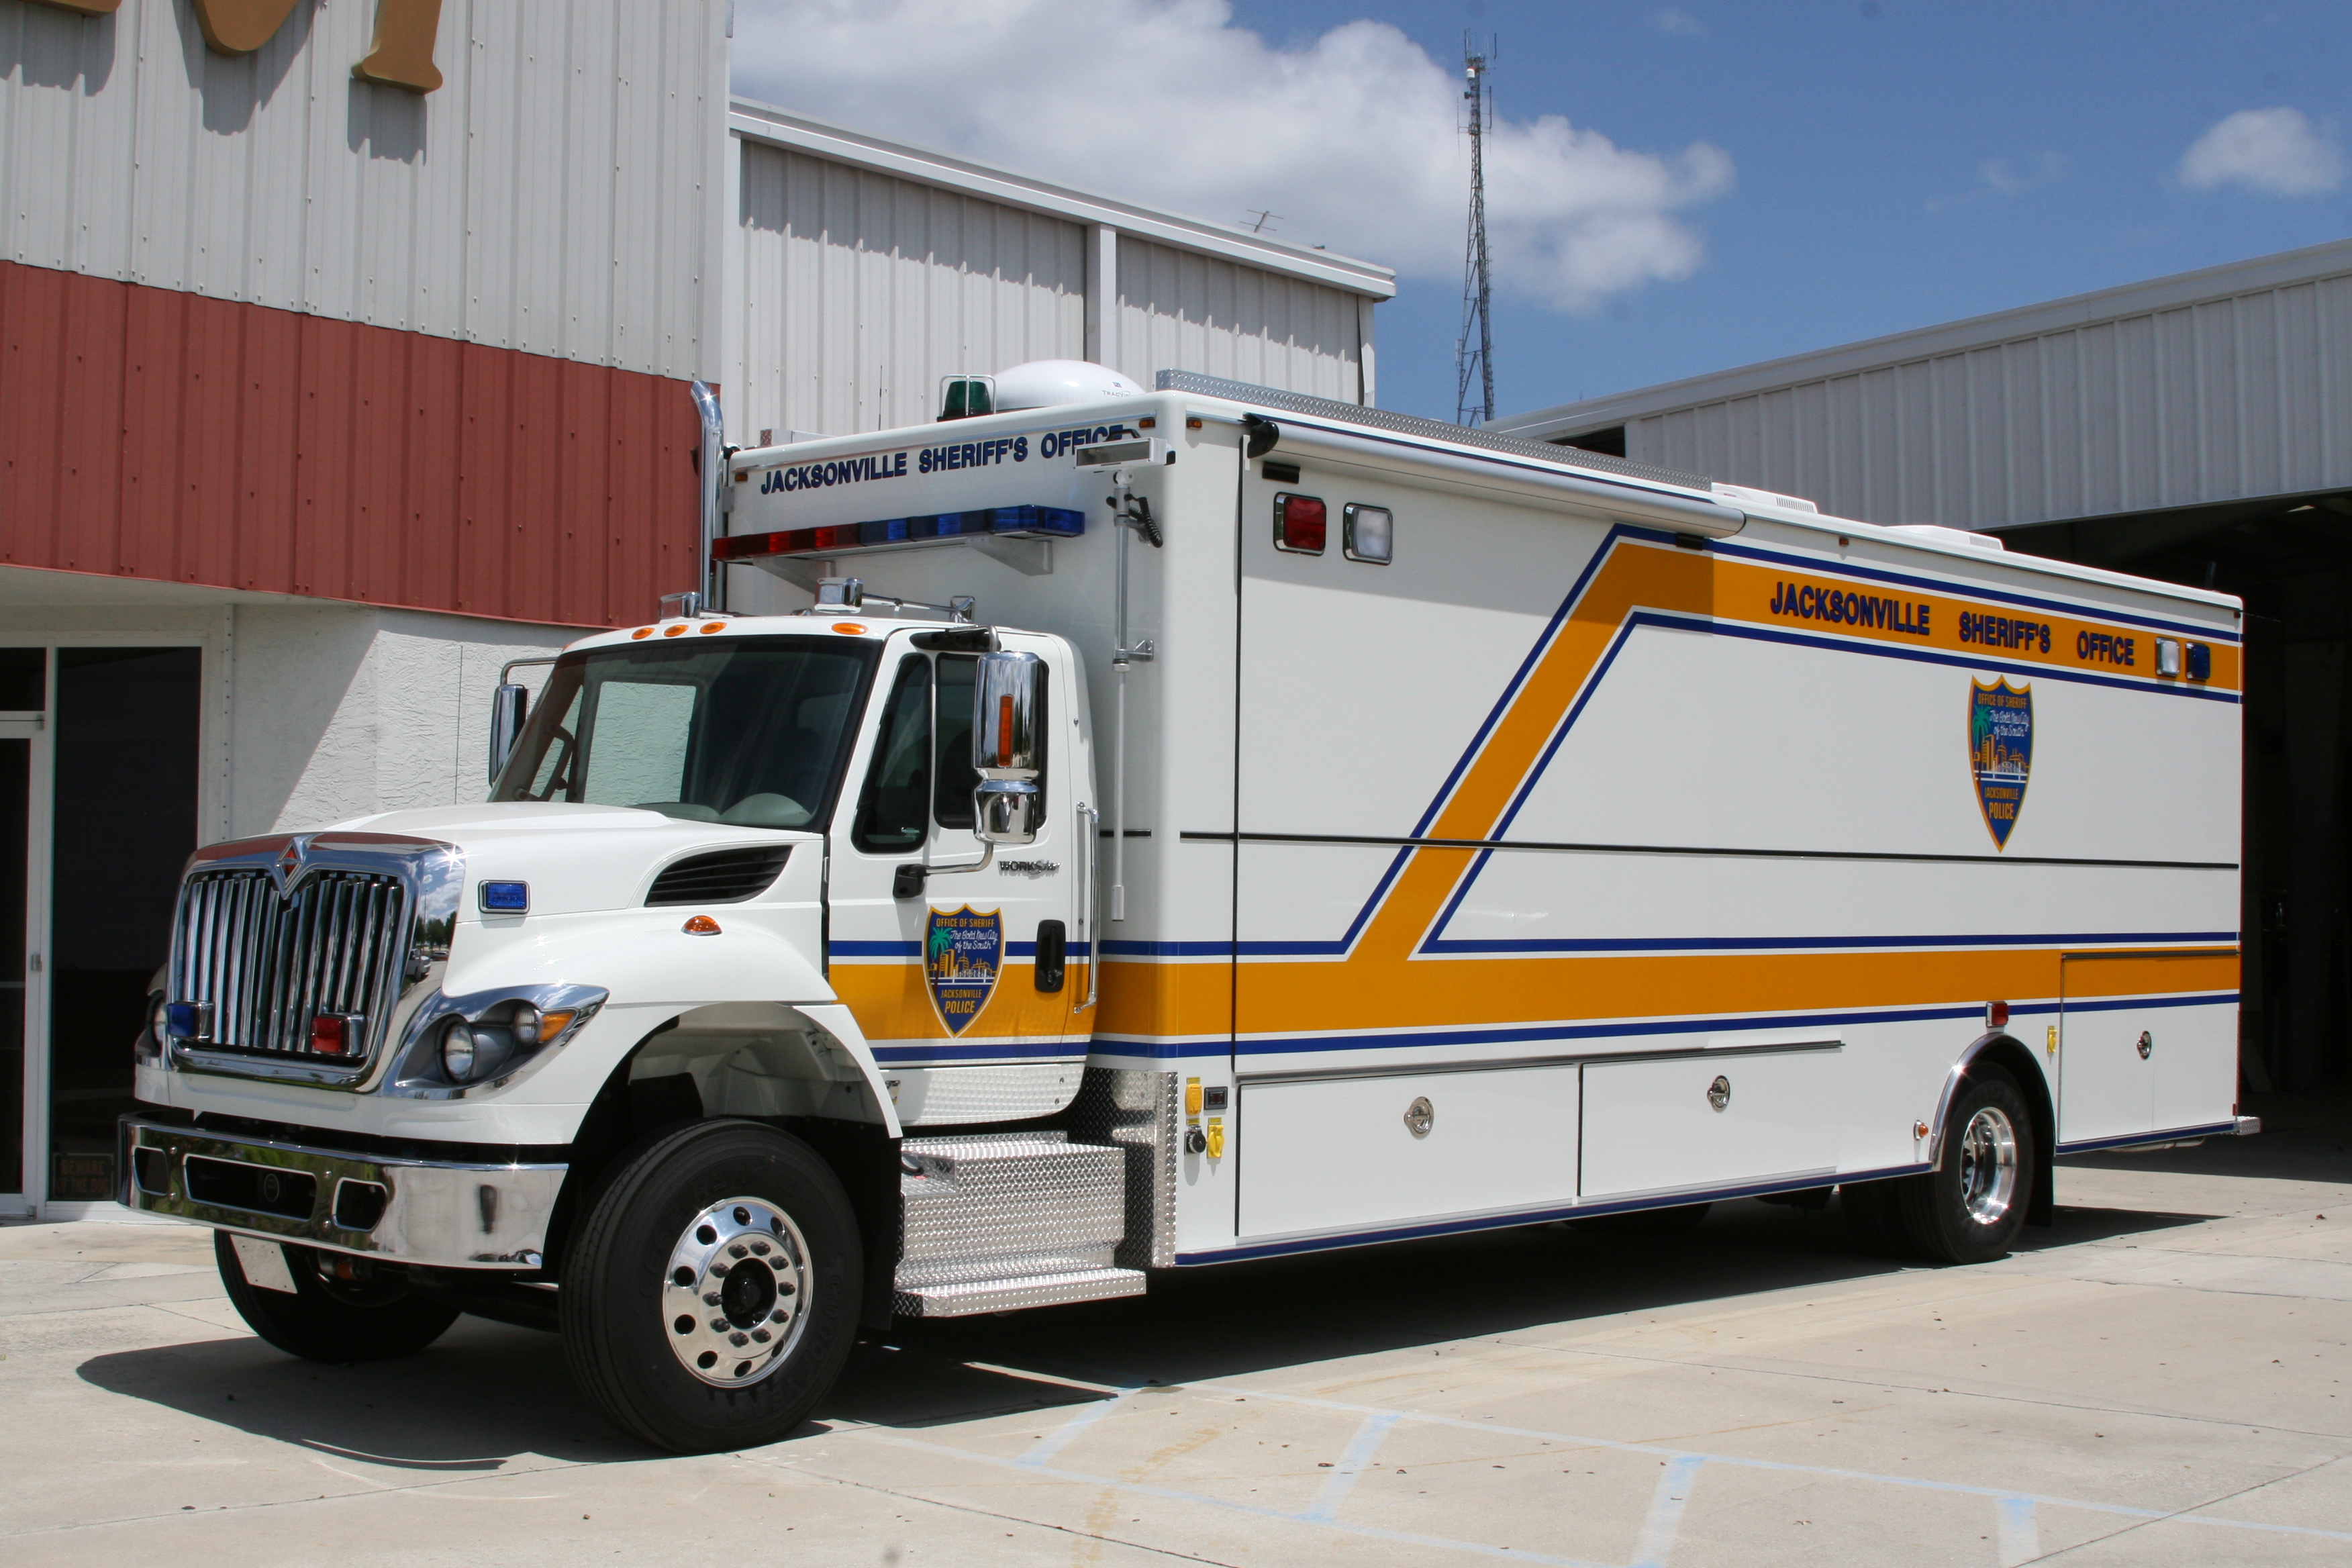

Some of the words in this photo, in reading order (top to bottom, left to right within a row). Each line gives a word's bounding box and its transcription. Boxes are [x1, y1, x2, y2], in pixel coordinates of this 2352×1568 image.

[761, 452, 908, 495] JACKSONVILLE
[918, 436, 1028, 473] SHERIFF'S
[1770, 582, 1930, 636] JACKSONVILLE
[1959, 611, 2051, 653] SHERIFF'S
[2076, 630, 2135, 665] OFFICE
[1977, 693, 1996, 706] OFFICE
[1997, 695, 2004, 707] OF
[2005, 696, 2027, 709] SHERIFF
[1984, 787, 2019, 800] JACKSONVILLE
[1989, 801, 2014, 820] POLICE
[936, 918, 957, 927] OFFICE
[960, 918, 967, 927] OF
[969, 918, 995, 928] SHERIFF
[950, 930, 961, 939] The
[961, 930, 976, 940] Bold
[987, 929, 998, 945] City
[954, 940, 962, 953] of
[963, 940, 972, 949] the
[972, 940, 991, 950] South
[940, 989, 982, 998] JACKSONVILLE
[944, 1000, 975, 1014] POLICE
[60, 1160, 105, 1175] BEWARE
